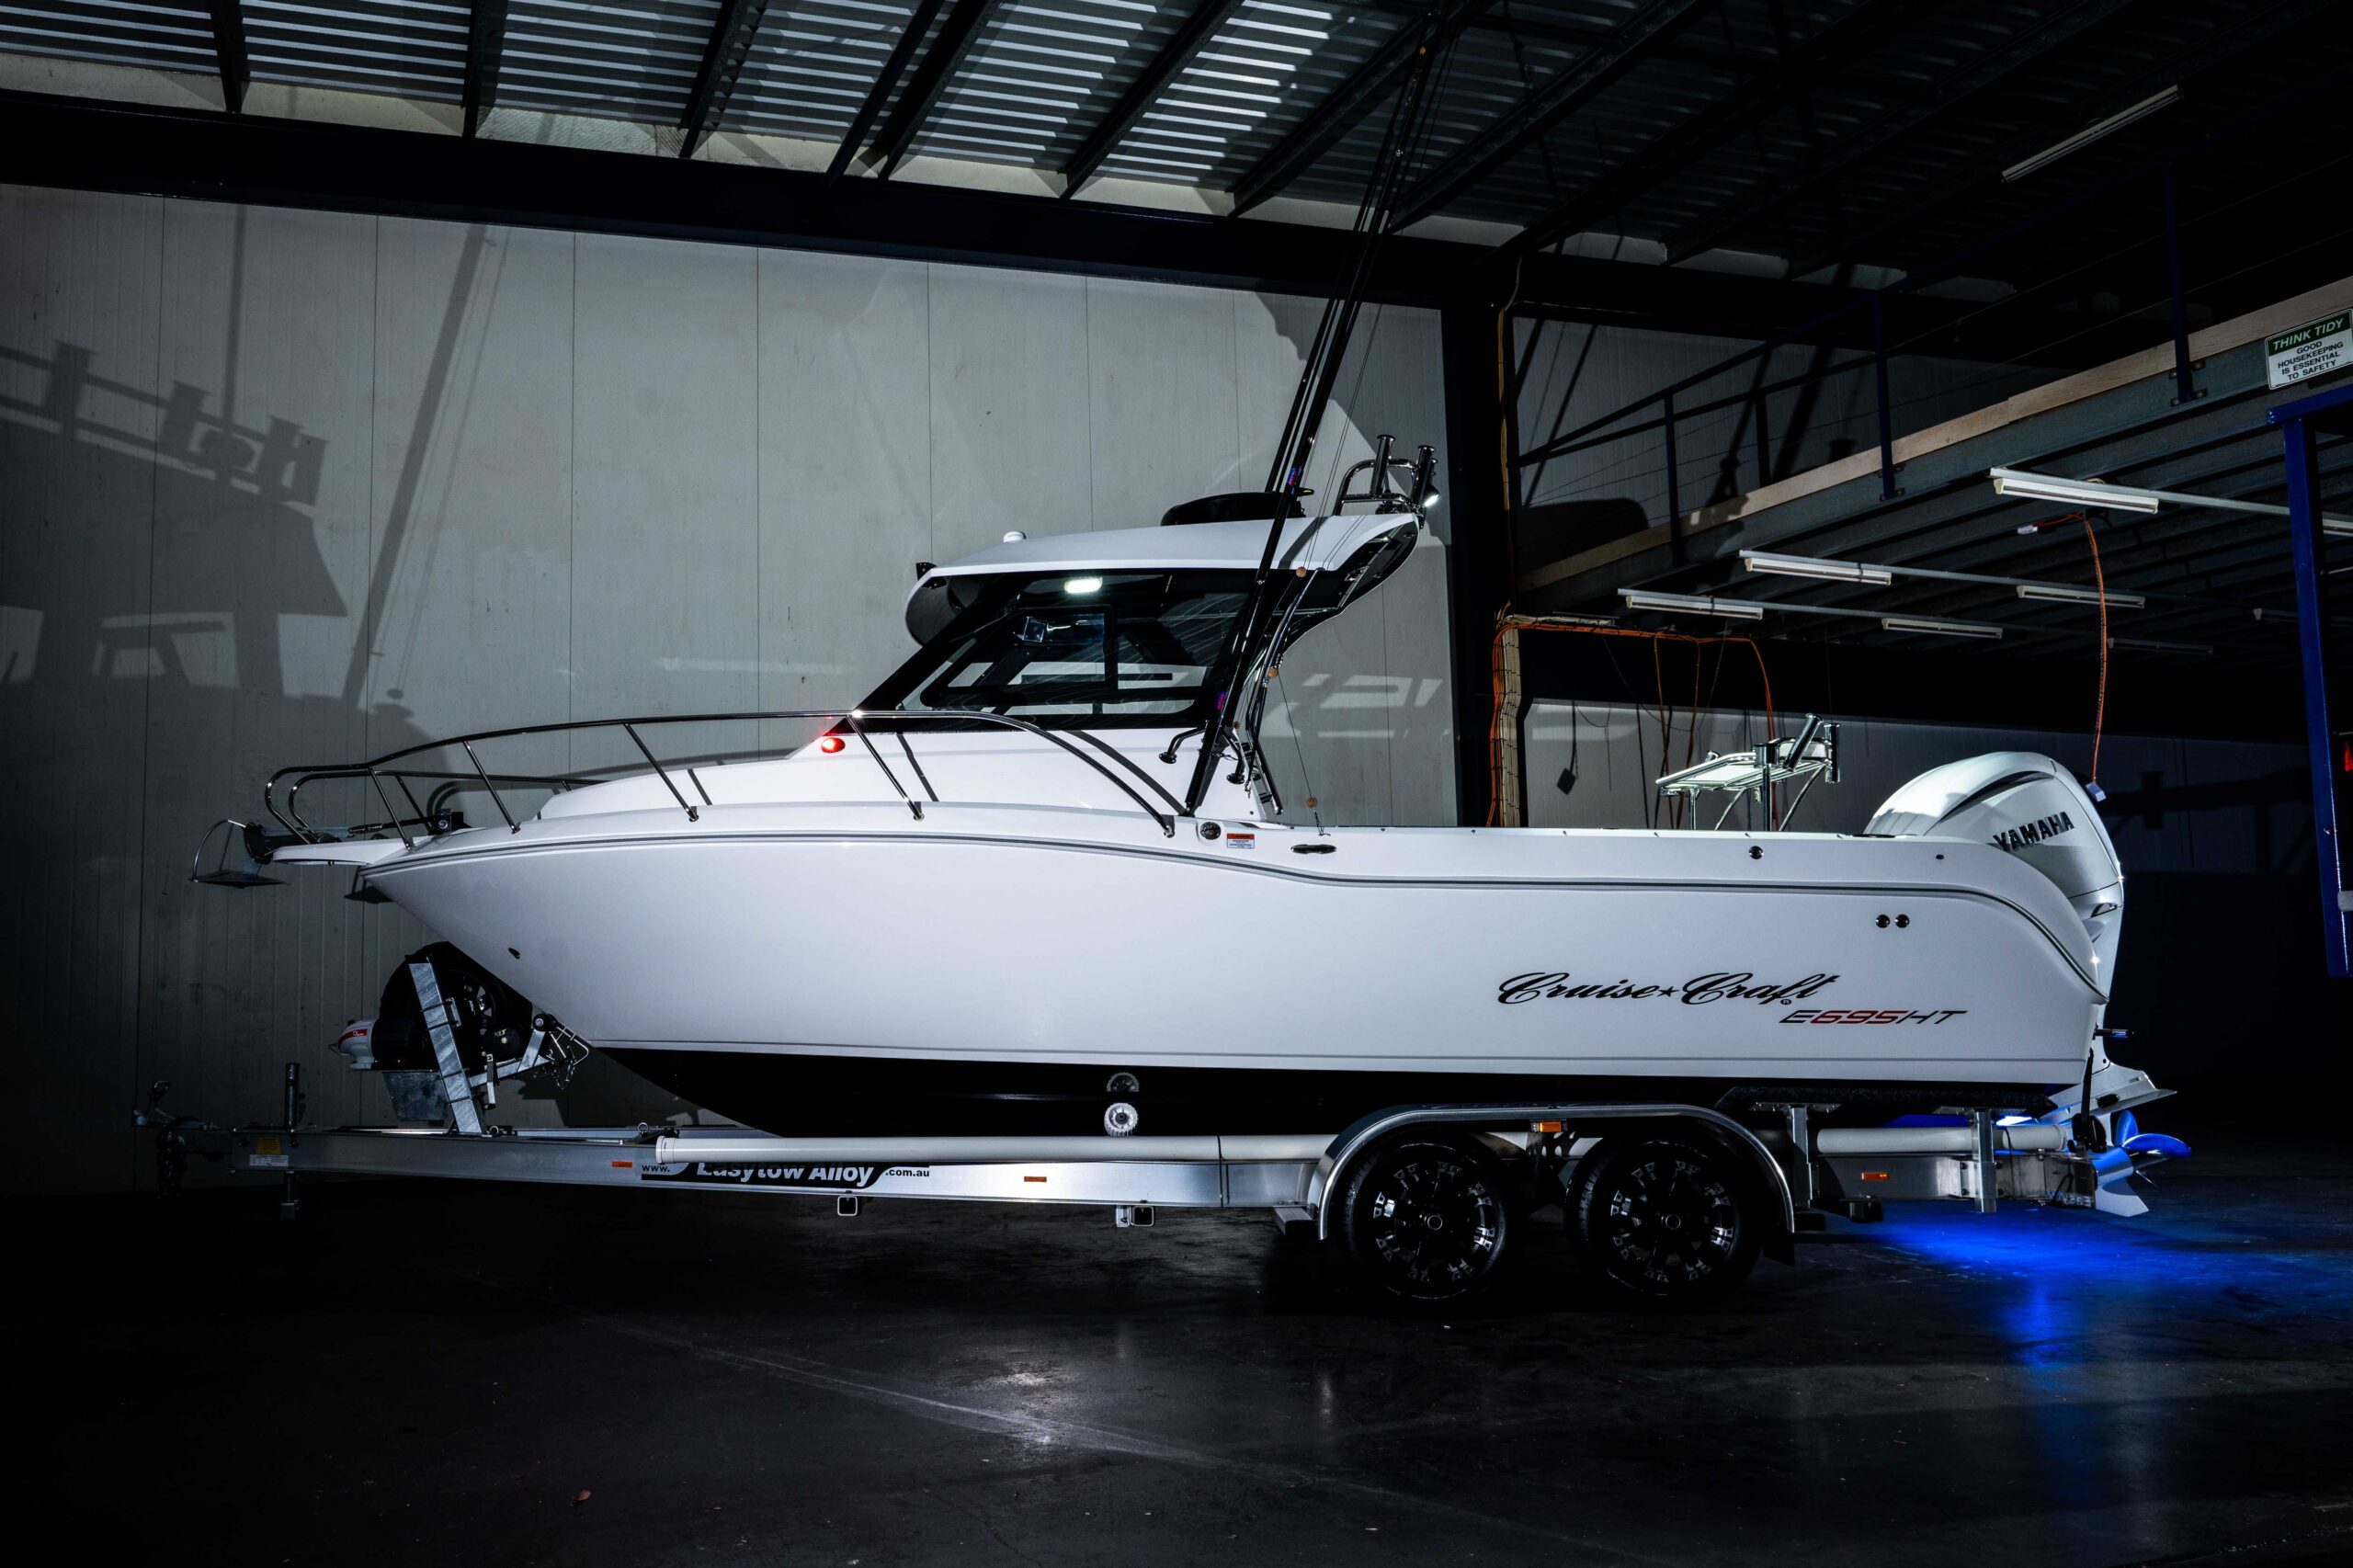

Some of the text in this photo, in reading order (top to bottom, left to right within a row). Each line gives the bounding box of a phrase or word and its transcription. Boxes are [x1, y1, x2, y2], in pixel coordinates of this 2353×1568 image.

[2273, 318, 2344, 351] THINK TIDY
[2278, 341, 2344, 369] HOUSEKEEPING
[2296, 341, 2323, 355] GOOD
[2288, 359, 2336, 381] TO SAFETY
[2293, 351, 2341, 371] ESSENTIAL
[1993, 812, 2075, 853] YAMAHA
[1497, 971, 1841, 1006] Cruise Craft
[1779, 1009, 1969, 1025] E695HT
[642, 1164, 671, 1174] www.
[808, 1162, 875, 1187] Alloy
[885, 1169, 930, 1177] .com.au
